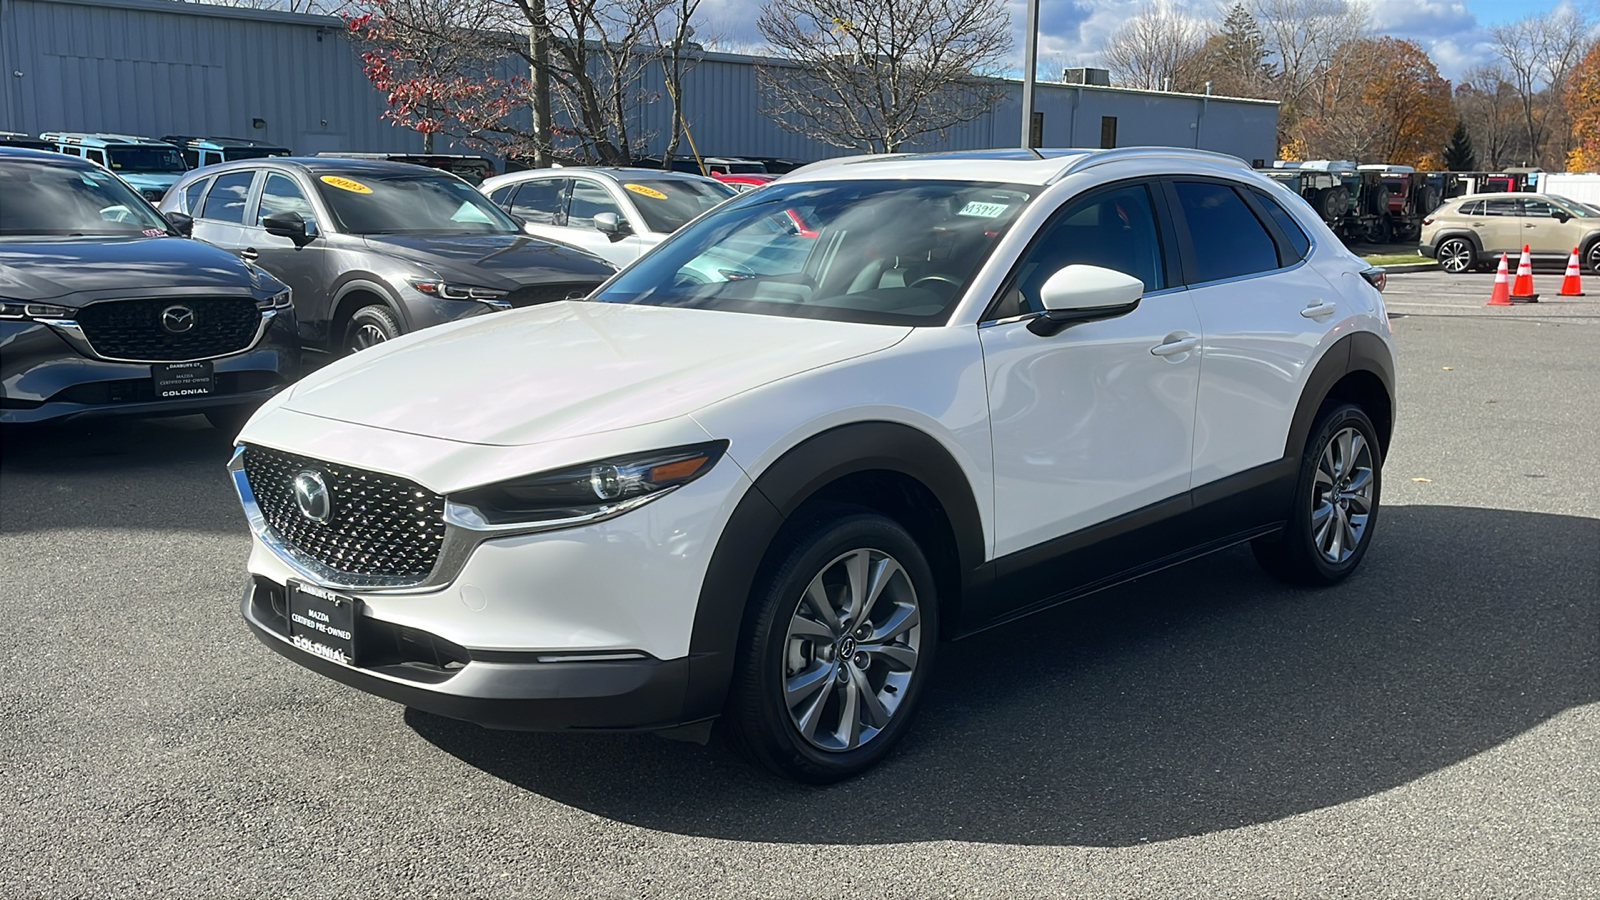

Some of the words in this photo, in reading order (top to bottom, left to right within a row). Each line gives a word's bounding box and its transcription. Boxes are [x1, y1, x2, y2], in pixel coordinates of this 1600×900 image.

[328, 178, 365, 191] 2023
[162, 388, 209, 397] COLONIAL
[308, 609, 330, 623] MAZDA
[291, 613, 316, 629] CERTIFIED
[315, 622, 352, 640] PRE-OWNED
[293, 636, 348, 664] COLONIAL
